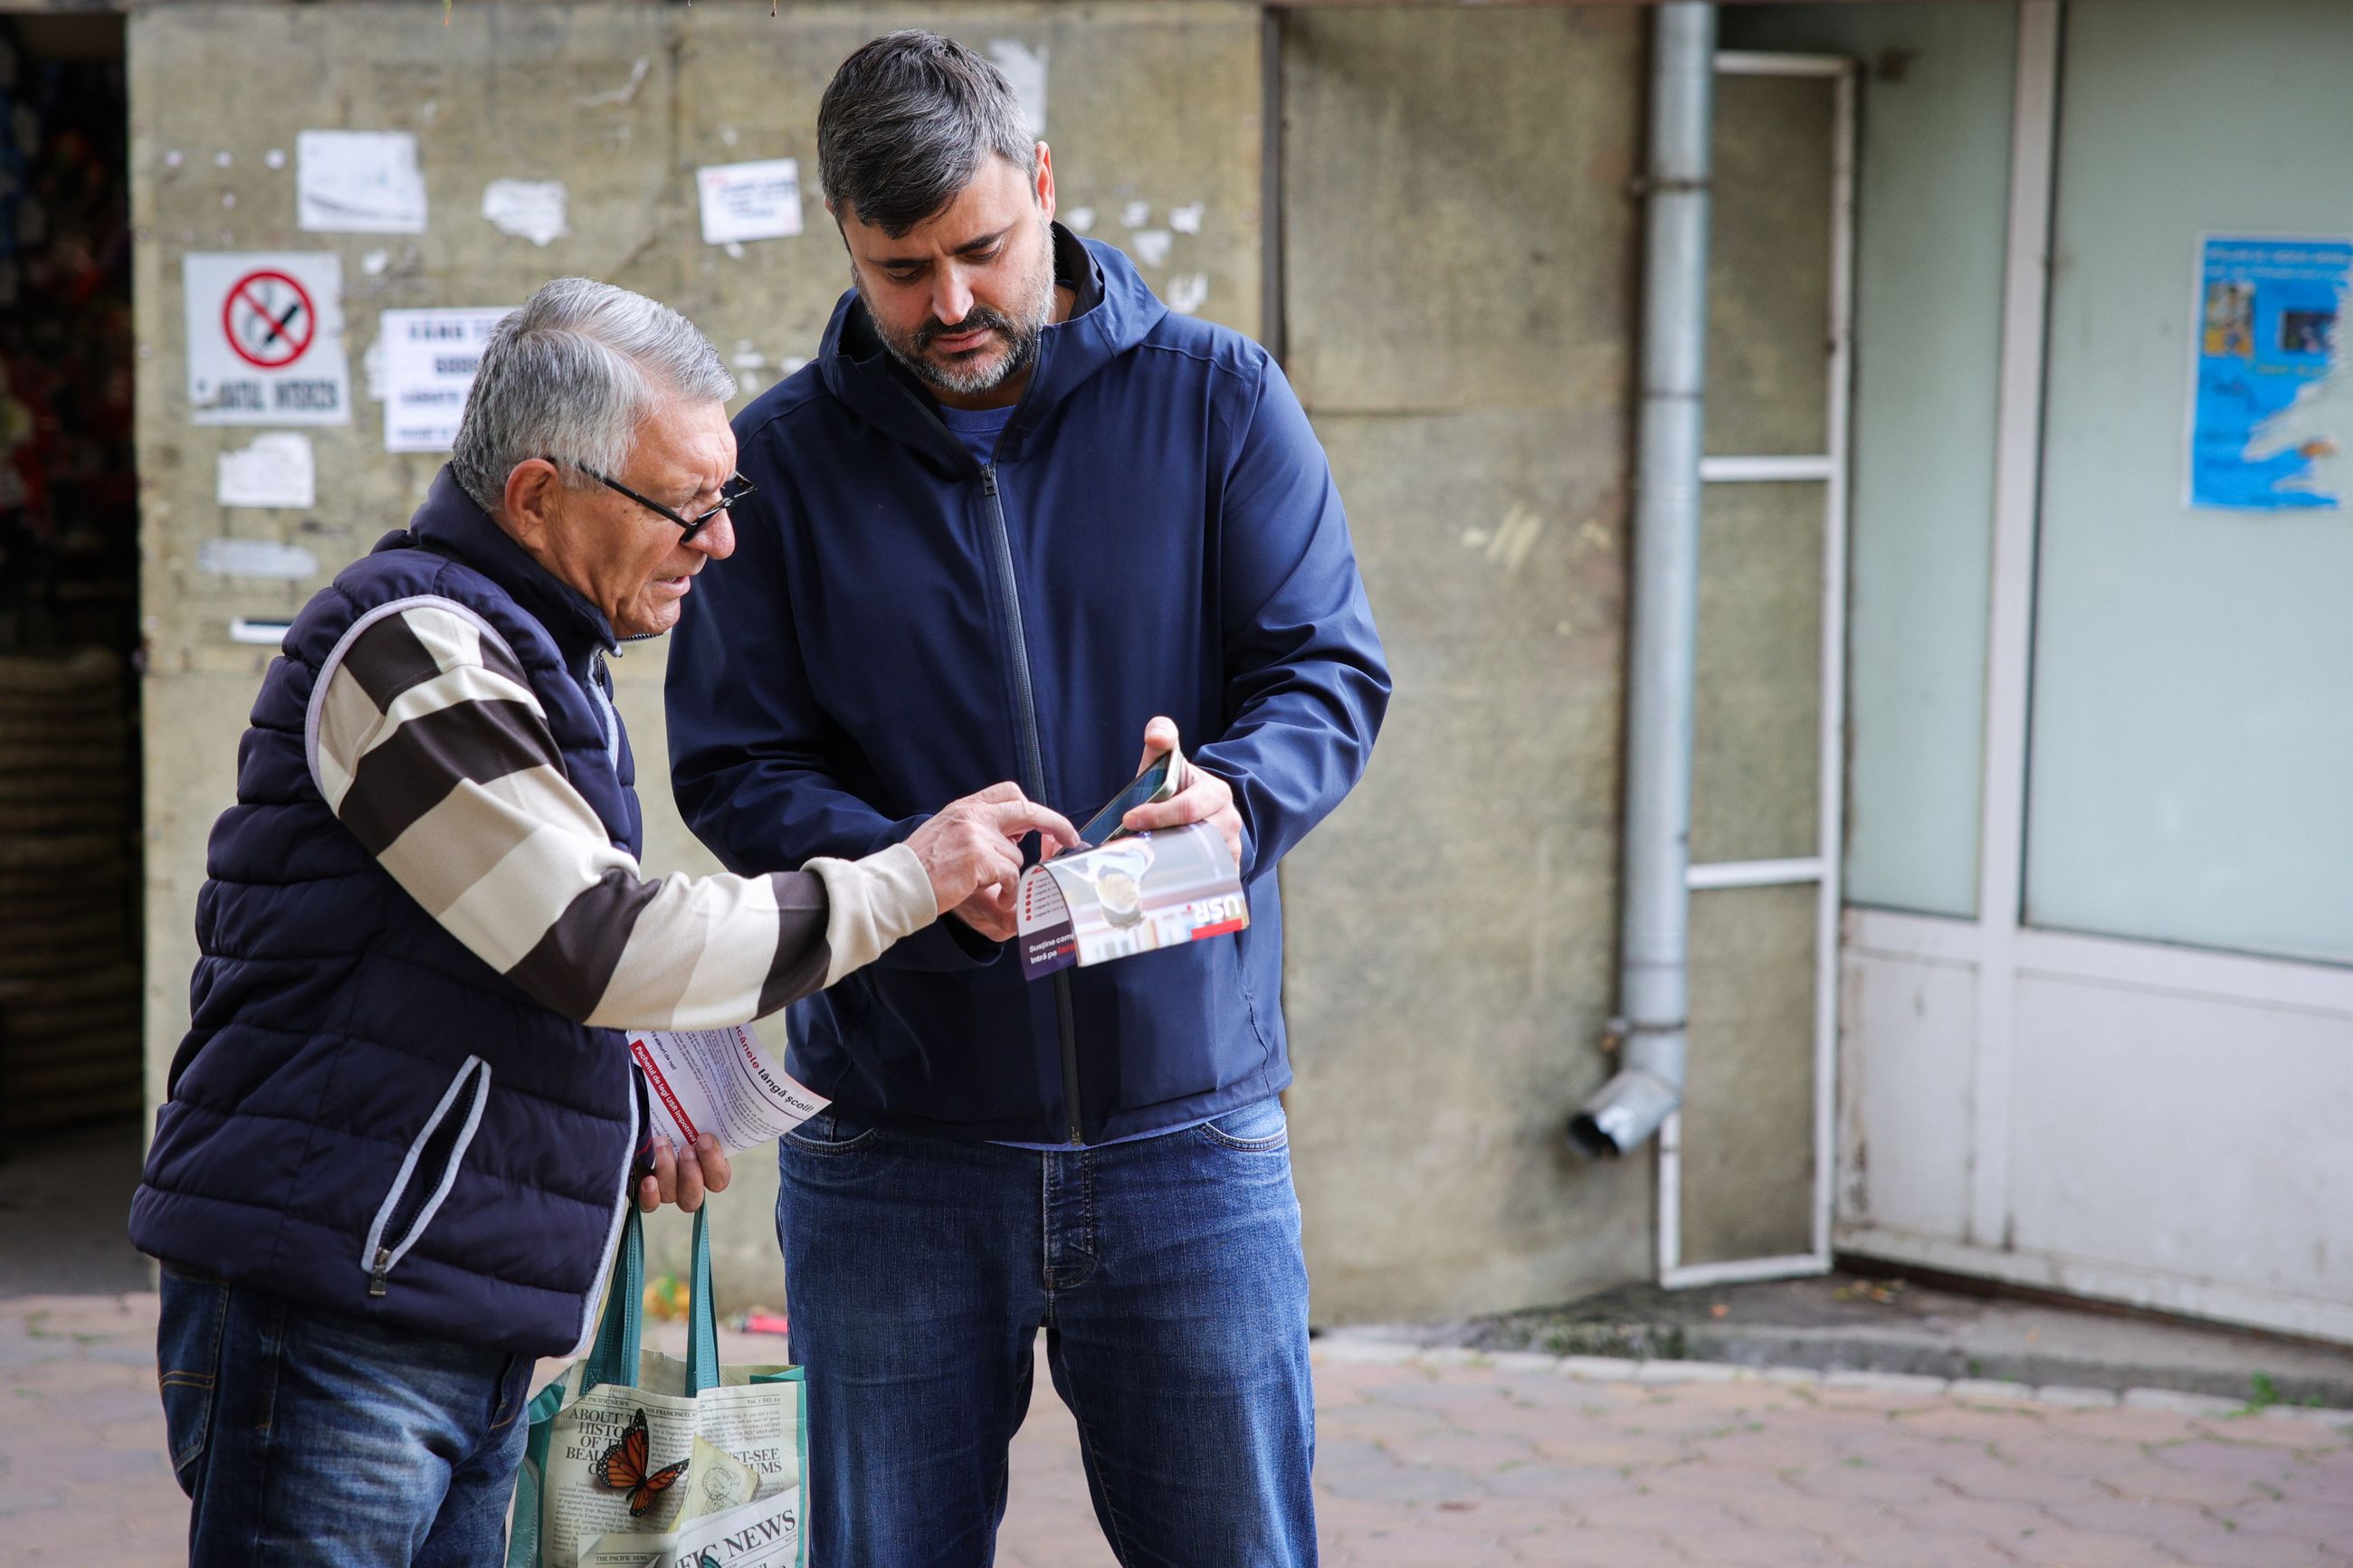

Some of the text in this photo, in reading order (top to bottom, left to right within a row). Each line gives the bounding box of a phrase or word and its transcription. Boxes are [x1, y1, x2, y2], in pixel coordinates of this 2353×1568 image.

[635, 1045, 656, 1076] Pachetul
[653, 1074, 661, 1084] de
[658, 1083, 671, 1098] legi
[666, 1096, 678, 1112] USR
[757, 1069, 787, 1098] lângă
[568, 1408, 624, 1425] ABOUT
[578, 1421, 624, 1438] HISTO
[580, 1435, 599, 1448] OF
[566, 1447, 604, 1462] BEAU
[729, 1448, 780, 1463] ST-SEE
[721, 1508, 796, 1559] NEWS
